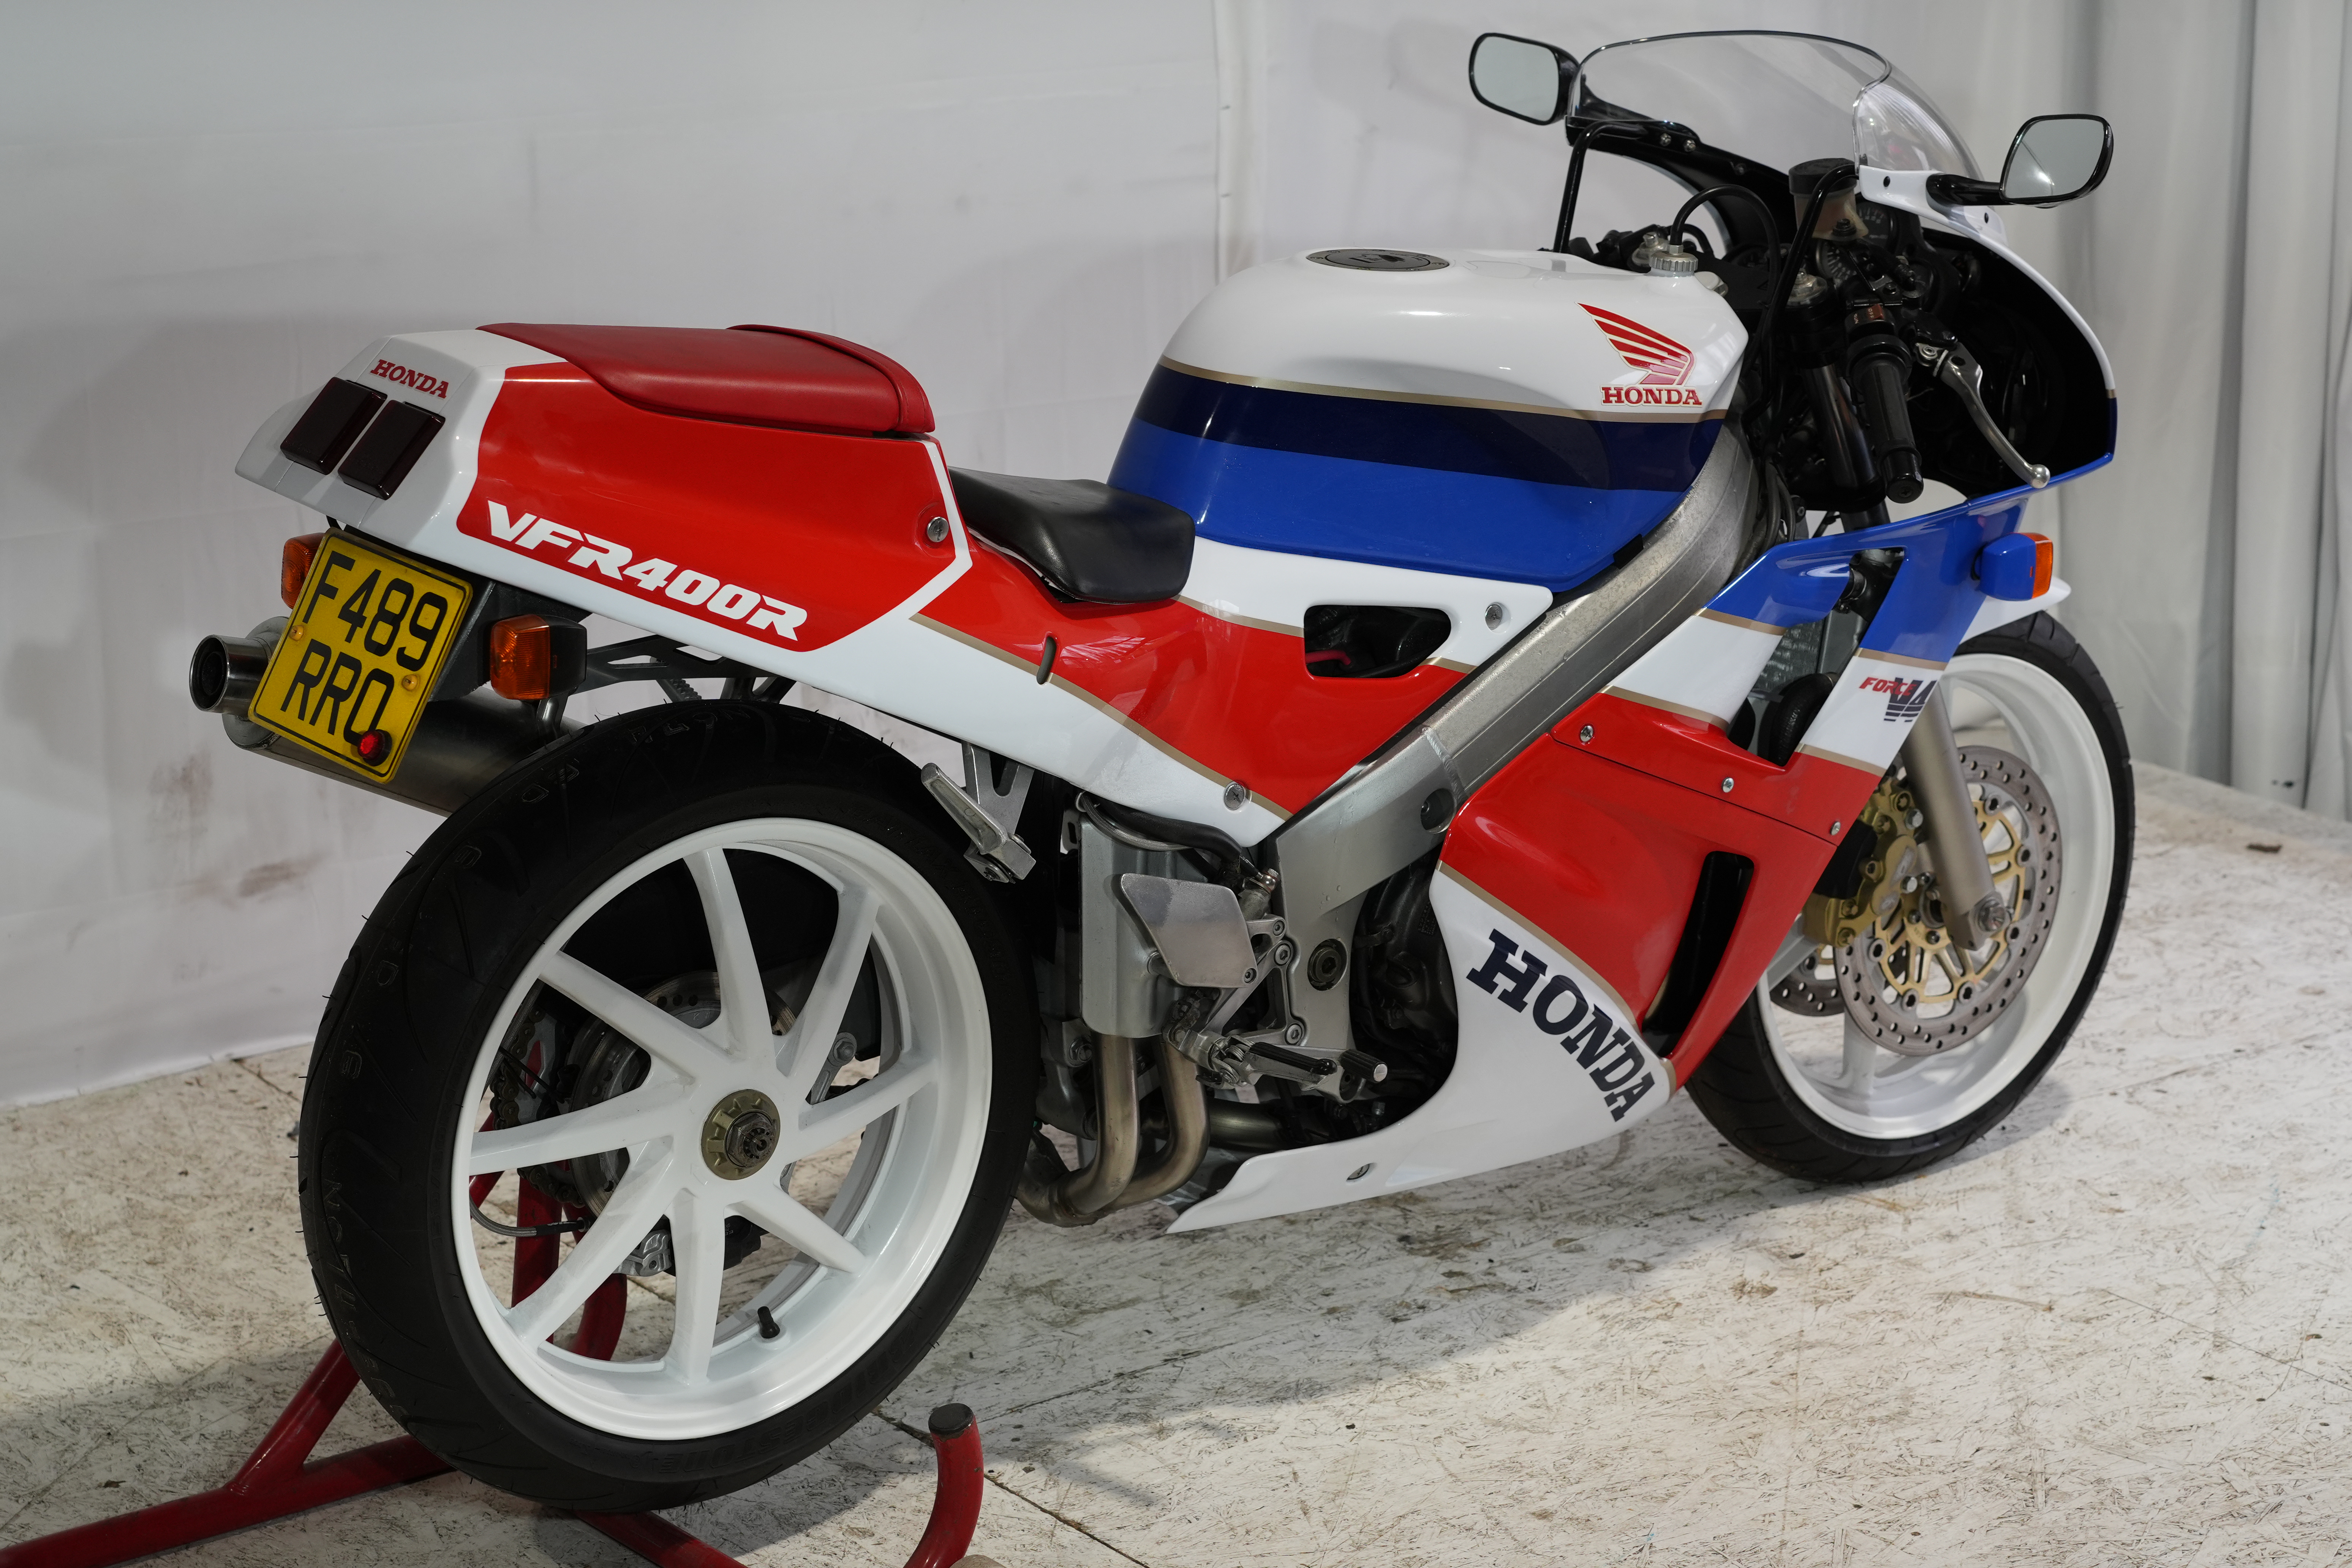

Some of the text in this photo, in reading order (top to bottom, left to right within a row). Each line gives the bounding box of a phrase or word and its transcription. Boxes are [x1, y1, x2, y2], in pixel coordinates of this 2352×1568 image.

[371, 360, 448, 398] HONDA
[1602, 387, 1702, 405] HONDA
[302, 550, 448, 672] F489
[487, 500, 807, 641] VFR400R
[280, 639, 395, 746] RRO
[1859, 677, 1917, 696] FORCE
[1466, 928, 1655, 1122] HONDA
[658, 1320, 922, 1474] BRIDGESTONE
